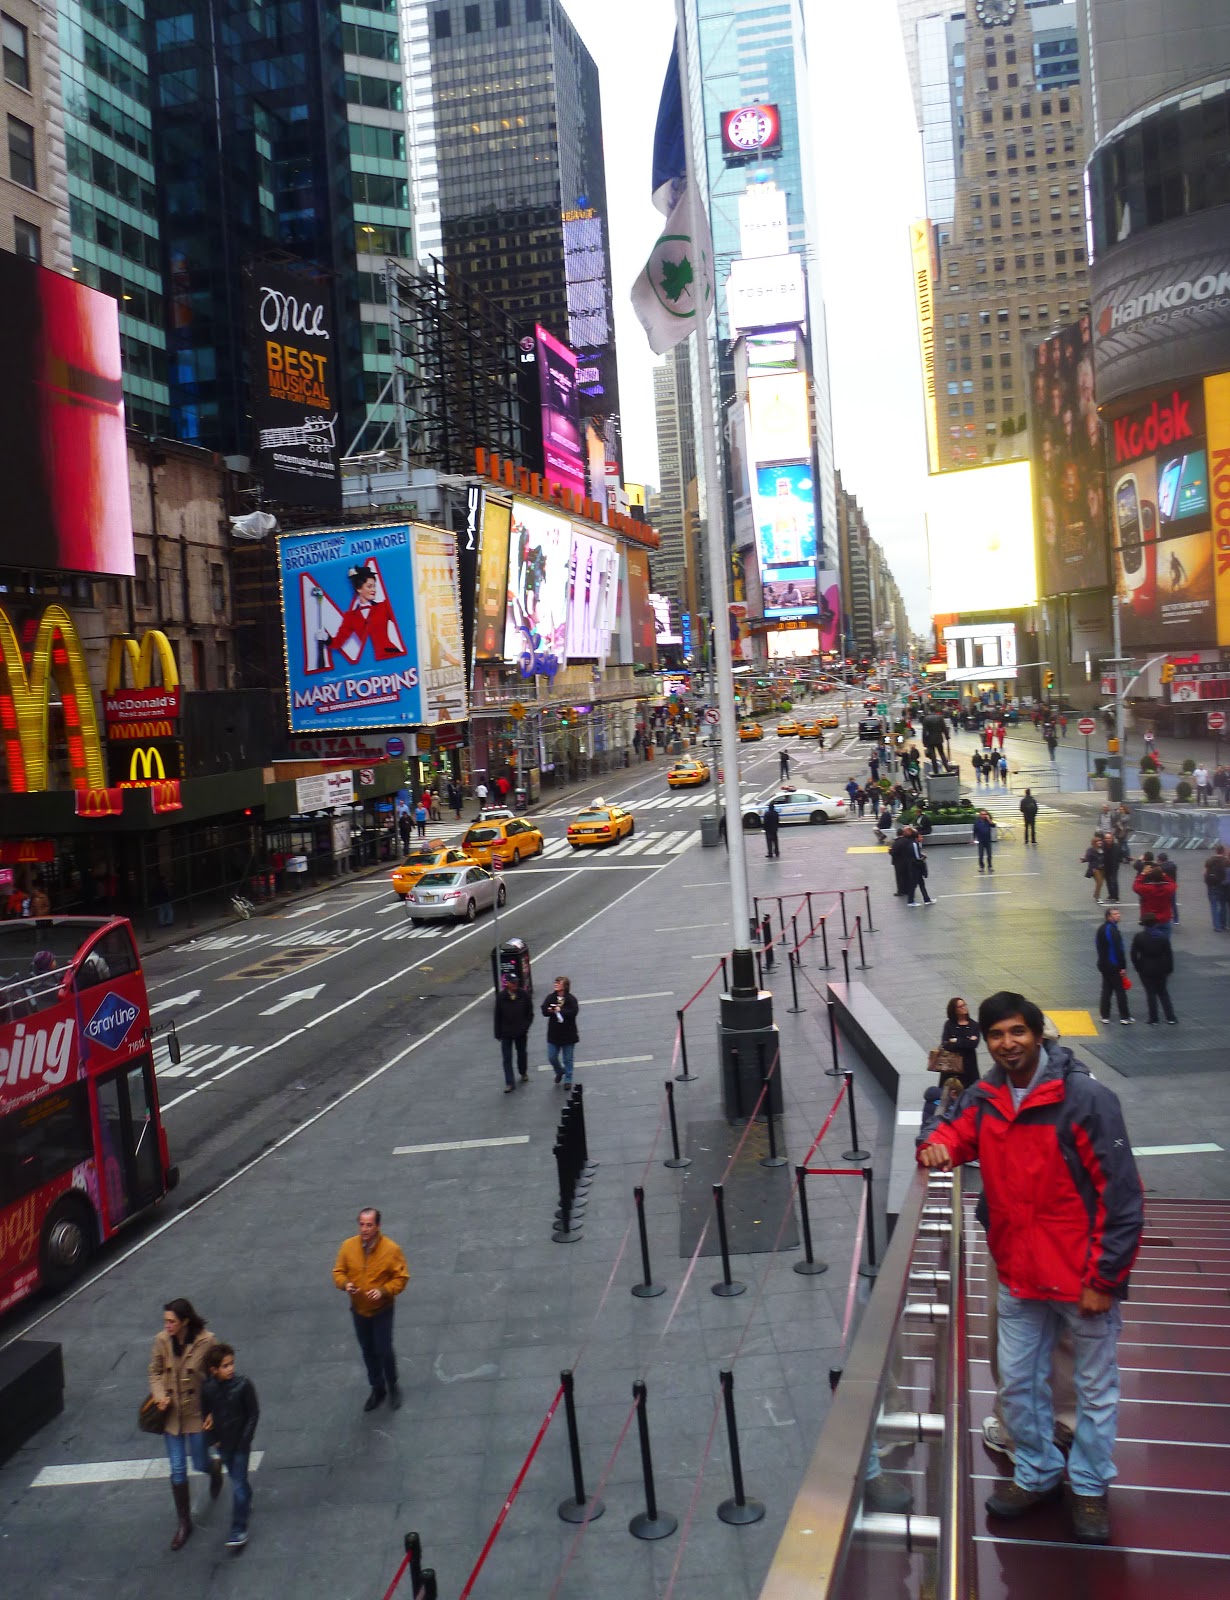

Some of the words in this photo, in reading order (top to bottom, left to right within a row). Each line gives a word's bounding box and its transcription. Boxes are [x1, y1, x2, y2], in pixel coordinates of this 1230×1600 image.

[744, 220, 782, 230] TOSHIBA
[738, 283, 796, 298] TOSHIBA
[1171, 297, 1230, 319] emotio
[266, 340, 327, 383] BEST
[520, 354, 535, 363] LG
[268, 369, 330, 400] MUSICAL
[1113, 390, 1193, 463] Kodak
[273, 452, 335, 471] oncemusical.com
[301, 536, 346, 554] EVERYTHING
[350, 538, 372, 557] AND
[374, 531, 407, 550] MORE!
[779, 614, 803, 622] SONY
[1172, 663, 1230, 673] ARQU
[294, 681, 343, 709] MARY
[345, 667, 419, 699] POPPINS
[107, 696, 176, 711] McDonald's
[118, 708, 165, 718] Restaurant
[289, 737, 366, 753] IGITAL
